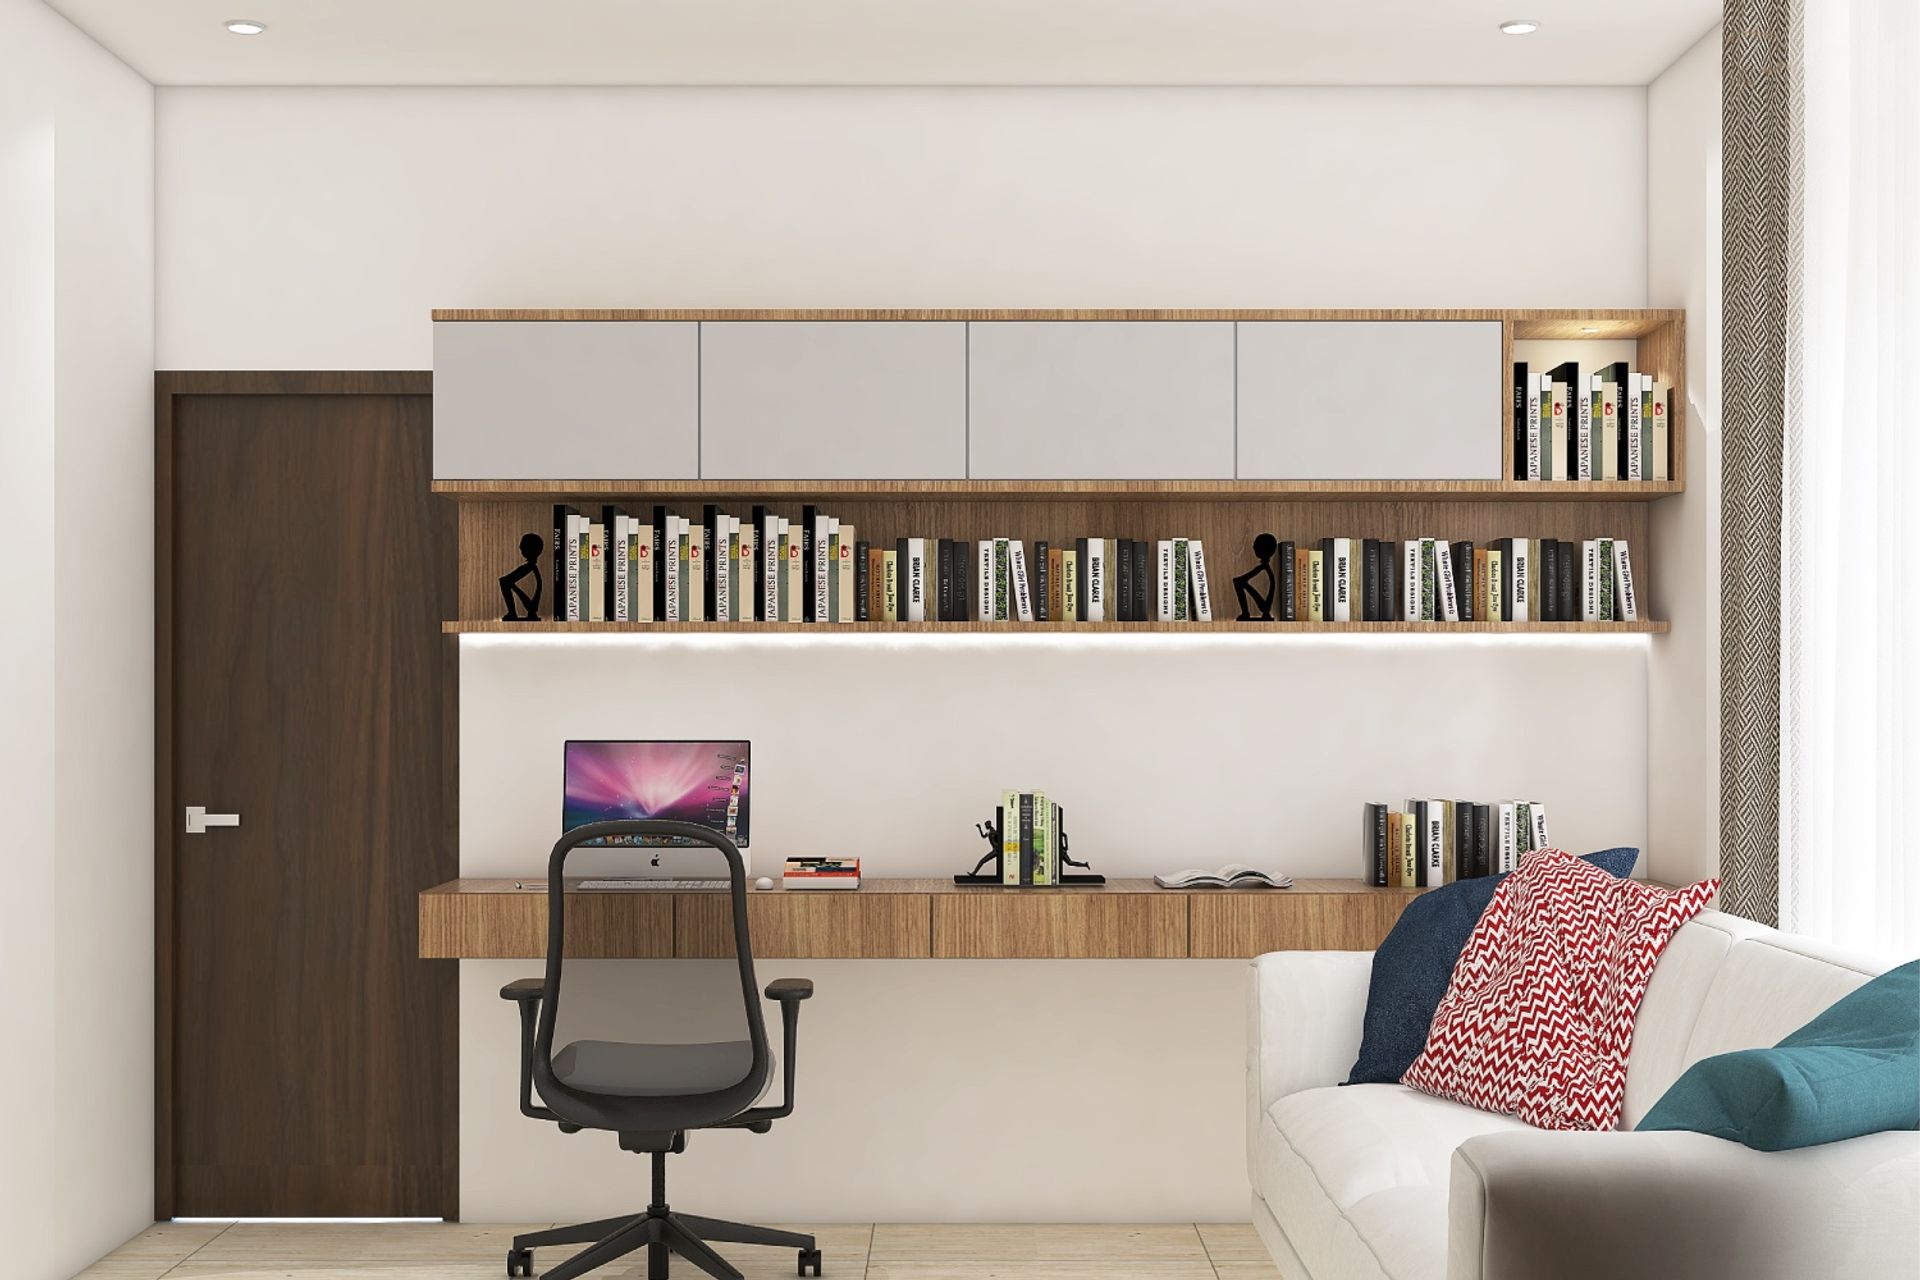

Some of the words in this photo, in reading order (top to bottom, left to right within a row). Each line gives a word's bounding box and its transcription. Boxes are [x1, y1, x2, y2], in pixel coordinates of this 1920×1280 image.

[1530, 397, 1538, 430] PRINTS
[1580, 397, 1588, 430] PRINTS
[1631, 397, 1639, 430] PRINTS
[1530, 433, 1538, 478] JAPANESE
[1580, 433, 1588, 478] JAPANESE
[1631, 433, 1639, 478] JAPANESE
[568, 539, 577, 571] PRINTS
[616, 540, 625, 572] PRINTS
[668, 540, 676, 572] PRINTS
[718, 539, 727, 571] PRINTS
[766, 540, 775, 572] PRINTS
[818, 540, 826, 572] PRINTS
[1338, 557, 1346, 578] BRIAN
[568, 573, 577, 618] JAPANESE
[616, 574, 625, 619] JAPANESE
[668, 574, 676, 619] JAPANESE
[718, 574, 727, 619] JAPANESE
[766, 574, 775, 619] JAPANESE
[818, 575, 826, 619] JAPANESE
[1338, 579, 1346, 603] CLARKE
